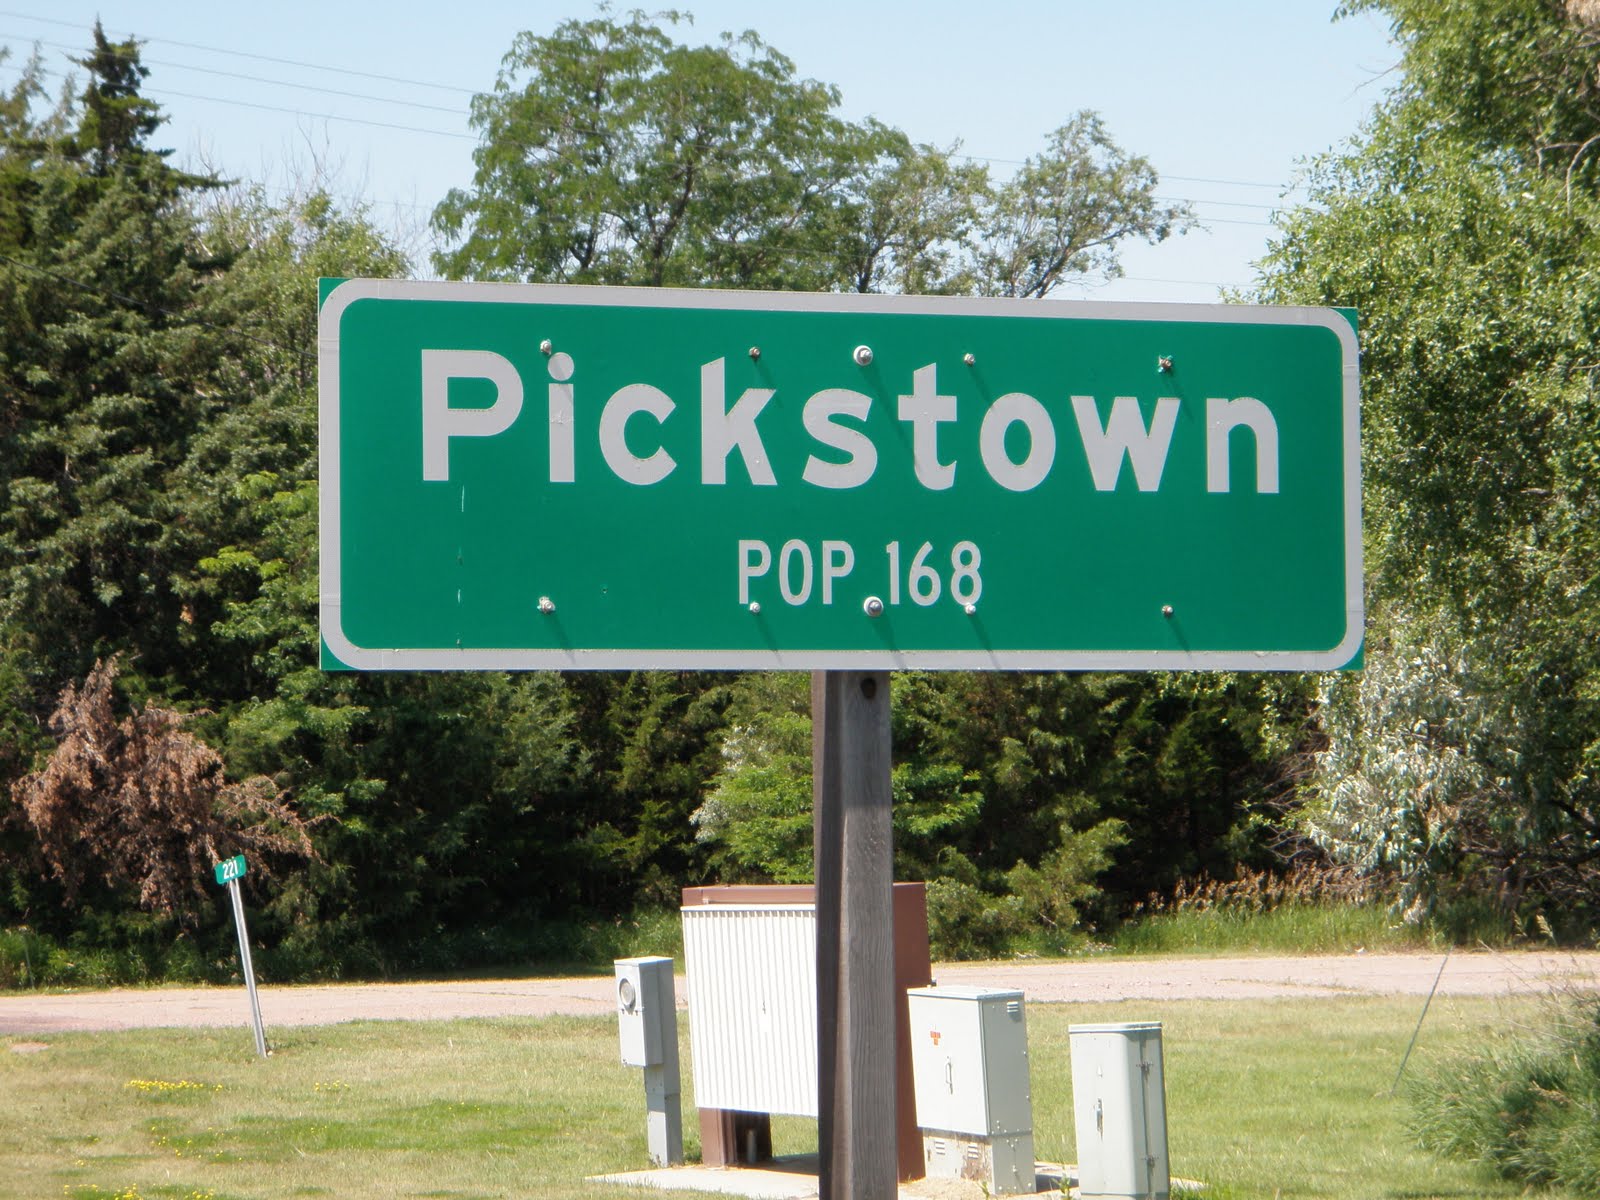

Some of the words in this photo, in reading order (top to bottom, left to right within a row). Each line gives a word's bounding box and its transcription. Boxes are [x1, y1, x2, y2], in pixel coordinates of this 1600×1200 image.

[421, 349, 1280, 494] Pickstown
[738, 539, 855, 606] POP
[886, 540, 982, 606] 168
[222, 859, 239, 880] 221
